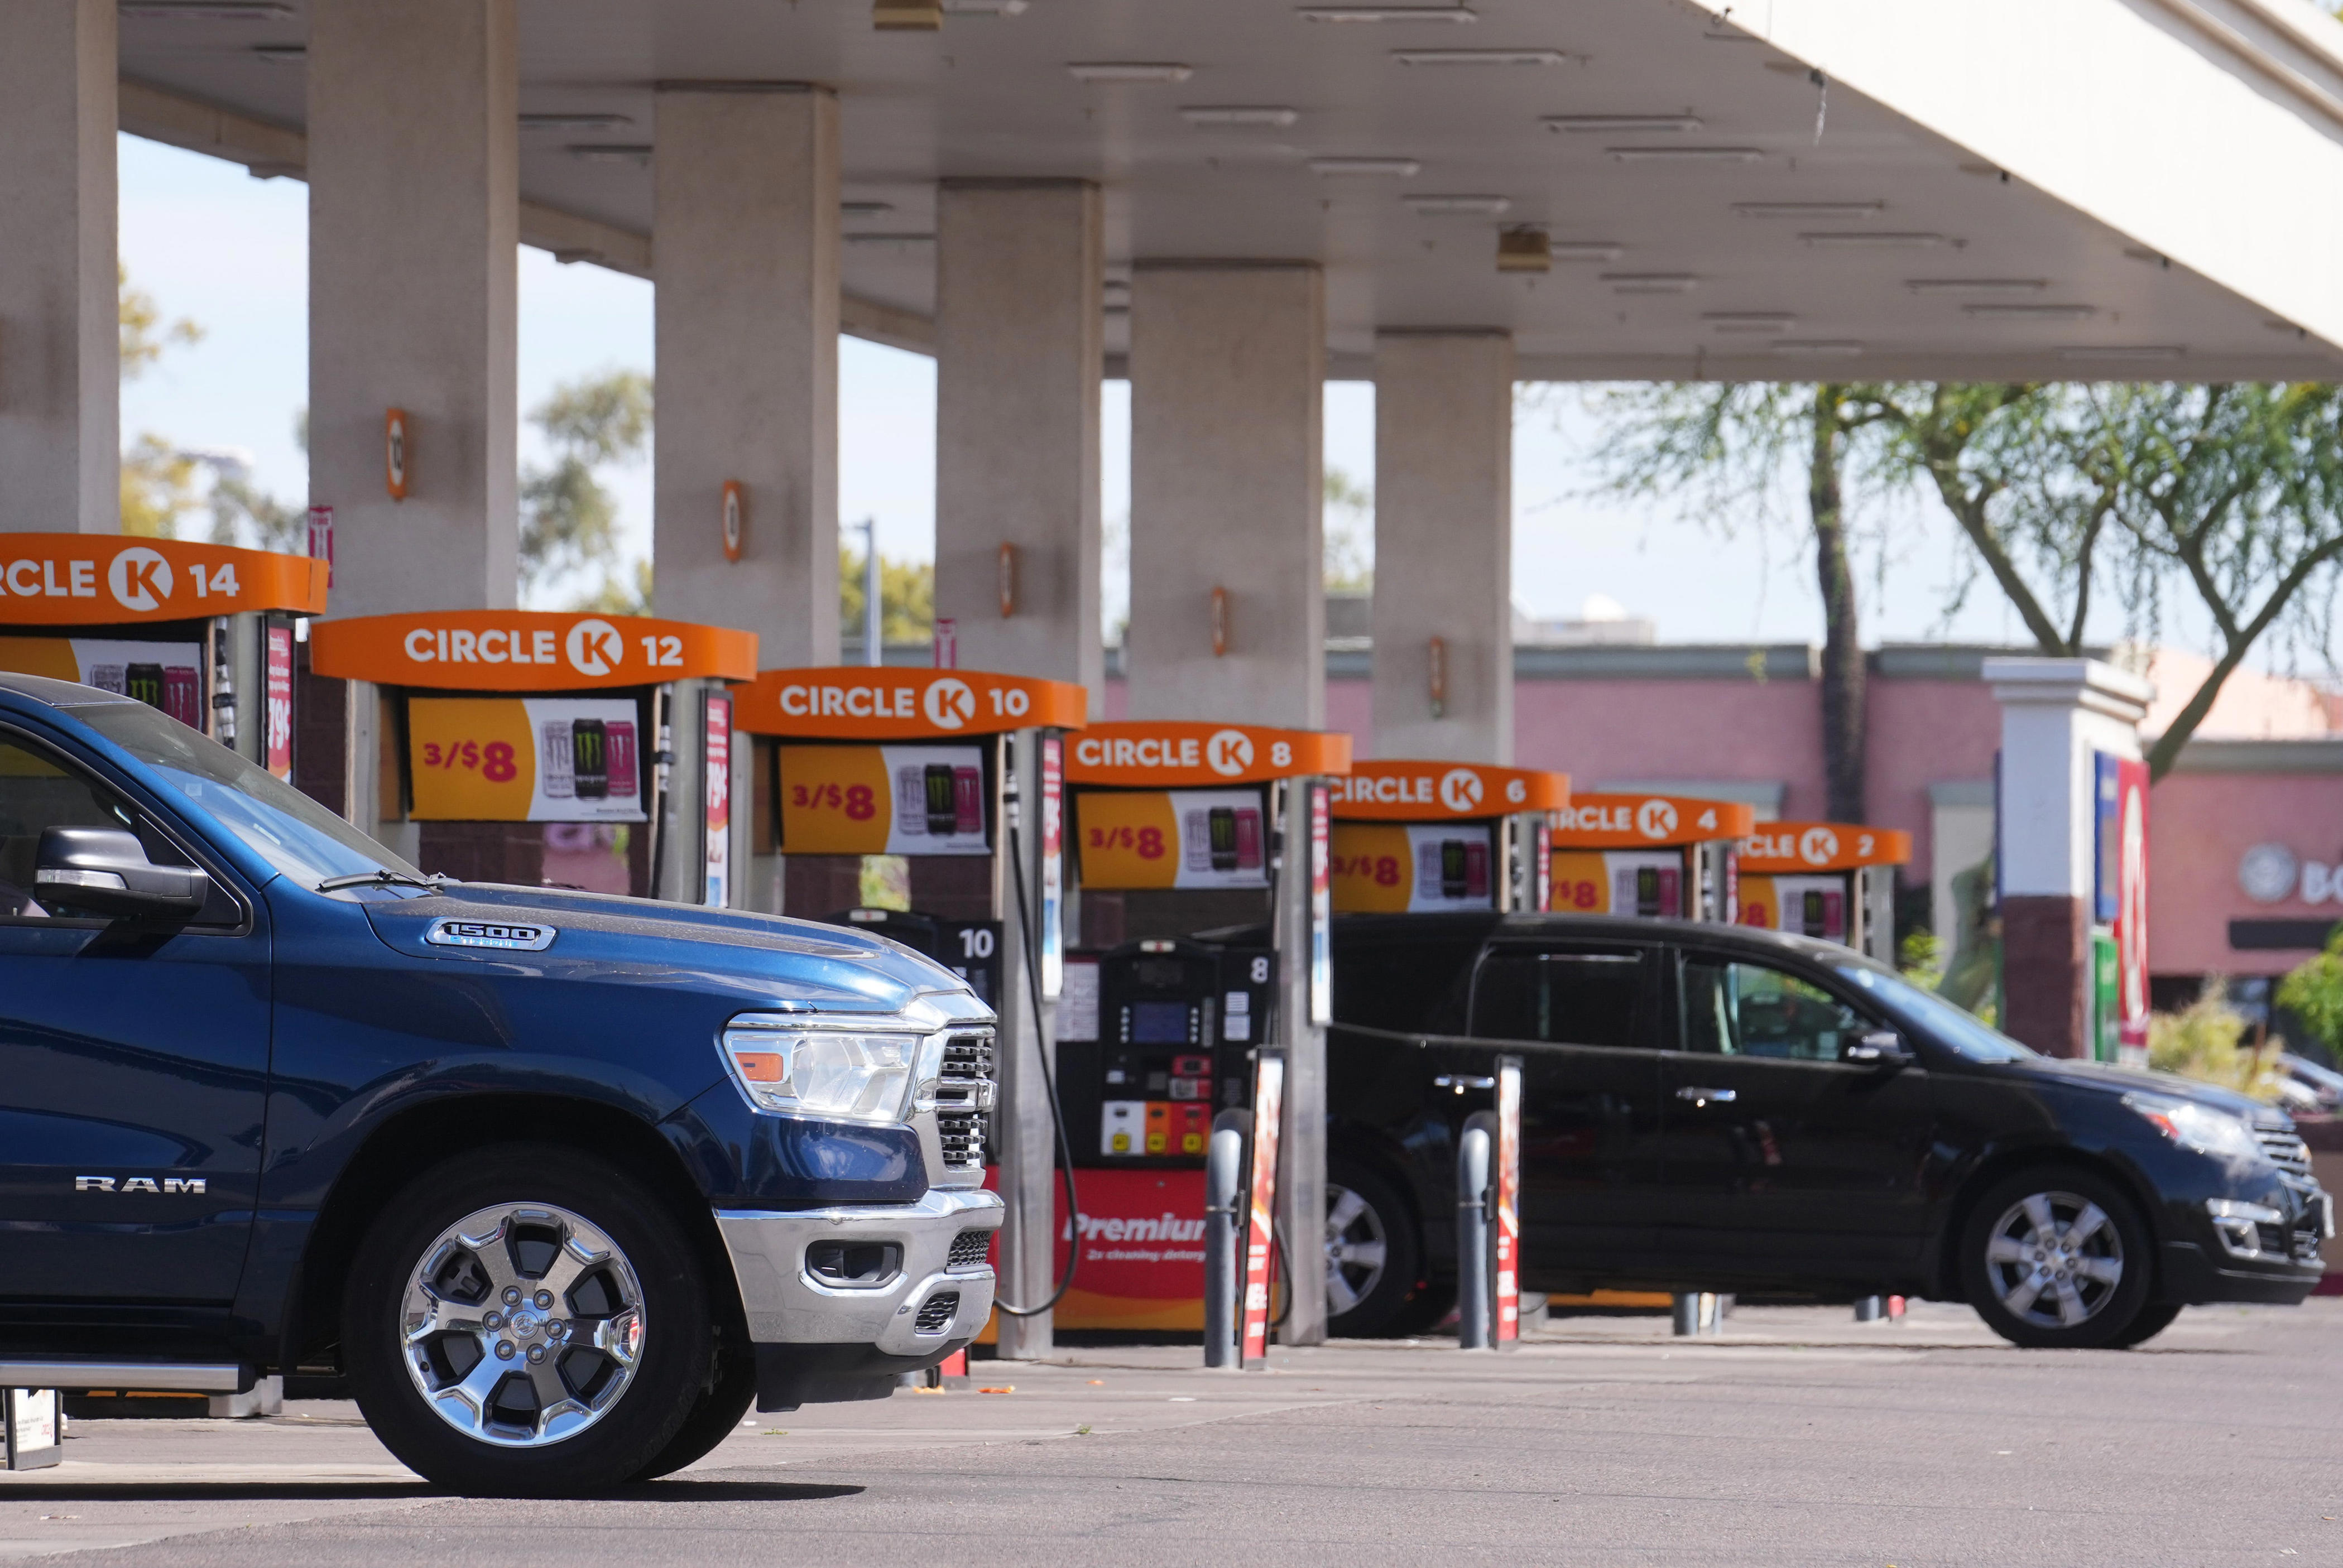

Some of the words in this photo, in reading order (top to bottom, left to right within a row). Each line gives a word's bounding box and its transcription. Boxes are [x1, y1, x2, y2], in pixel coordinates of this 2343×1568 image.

[189, 564, 240, 598] 14
[404, 628, 556, 664] CIRCLE
[641, 636, 684, 666] 12
[780, 684, 915, 718] CIRCLE
[988, 688, 1030, 717] 10
[424, 740, 517, 783] 3/$8
[1076, 738, 1200, 767] CIRCLE
[1270, 741, 1292, 767] 8
[793, 783, 876, 820] 3/$8
[1507, 778, 1526, 803] 6
[1697, 808, 1718, 831] 4
[447, 924, 535, 941] 1500
[959, 928, 995, 959] 10
[1250, 956, 1268, 984] 8
[75, 1176, 207, 1194] RAM
